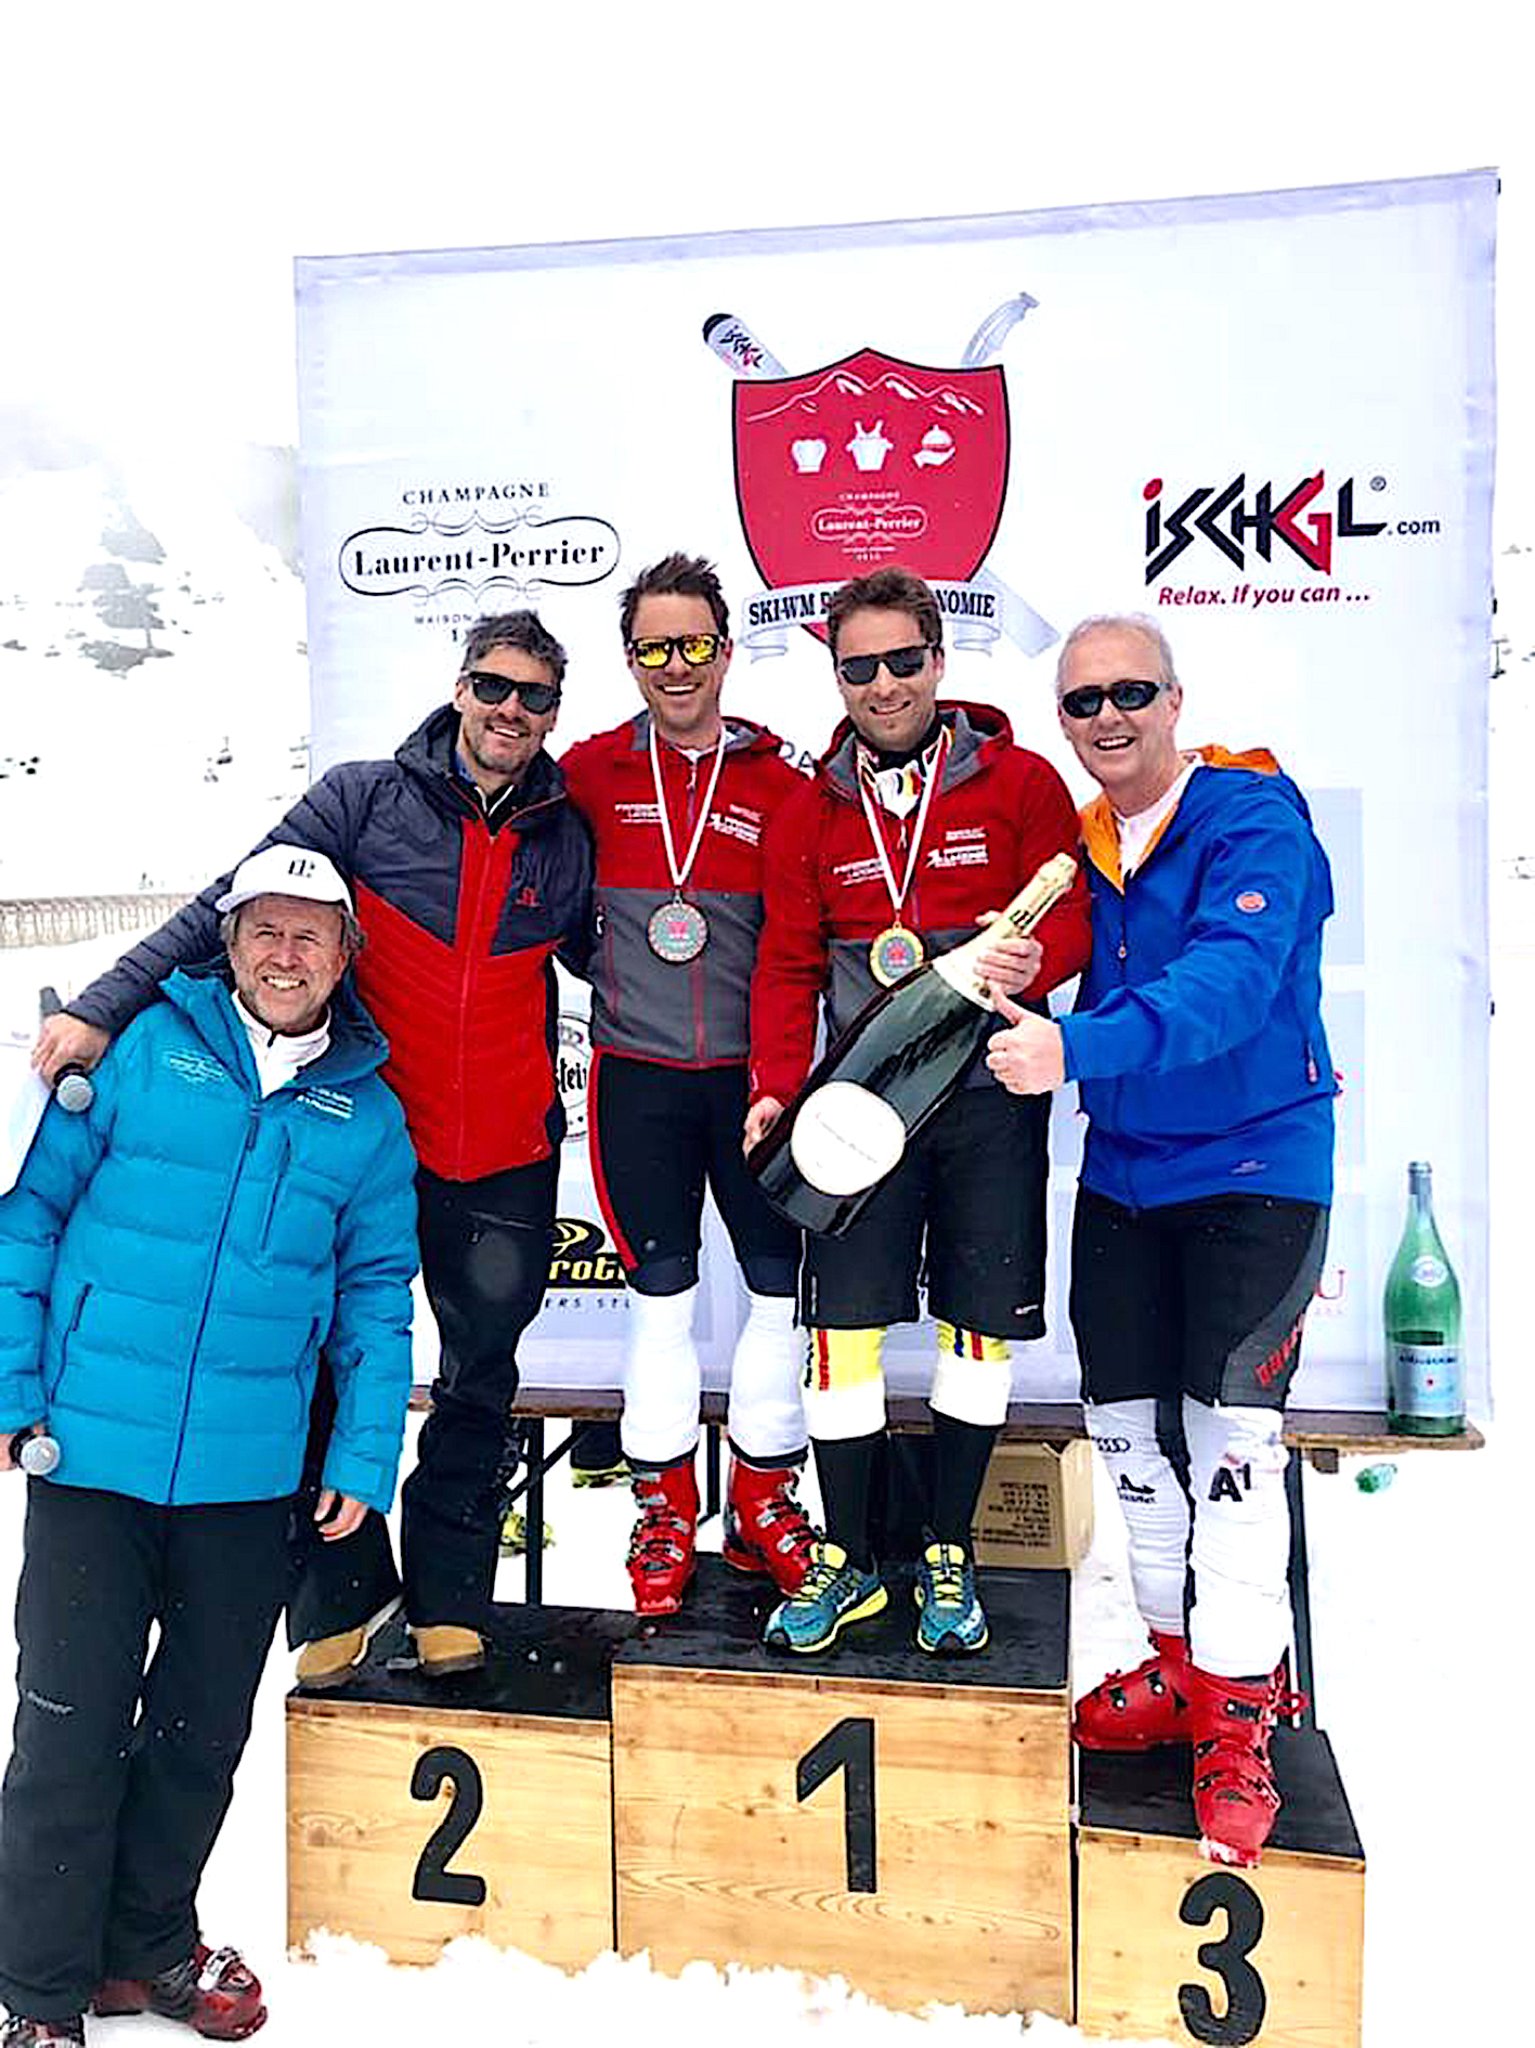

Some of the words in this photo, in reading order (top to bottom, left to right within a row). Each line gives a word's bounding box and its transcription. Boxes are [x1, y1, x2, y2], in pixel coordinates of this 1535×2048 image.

[402, 482, 550, 505] CHAMPAGNE
[818, 516, 921, 531] Laurent-Perrier
[354, 538, 605, 577] Laurent-Perrier
[1158, 585, 1227, 606] Relax.
[1252, 588, 1295, 609] you
[1300, 587, 1341, 604] can
[1207, 1463, 1252, 1503] A1
[795, 1718, 877, 1894] 1
[410, 1746, 487, 1906] 2
[1178, 1873, 1266, 2047] 3
